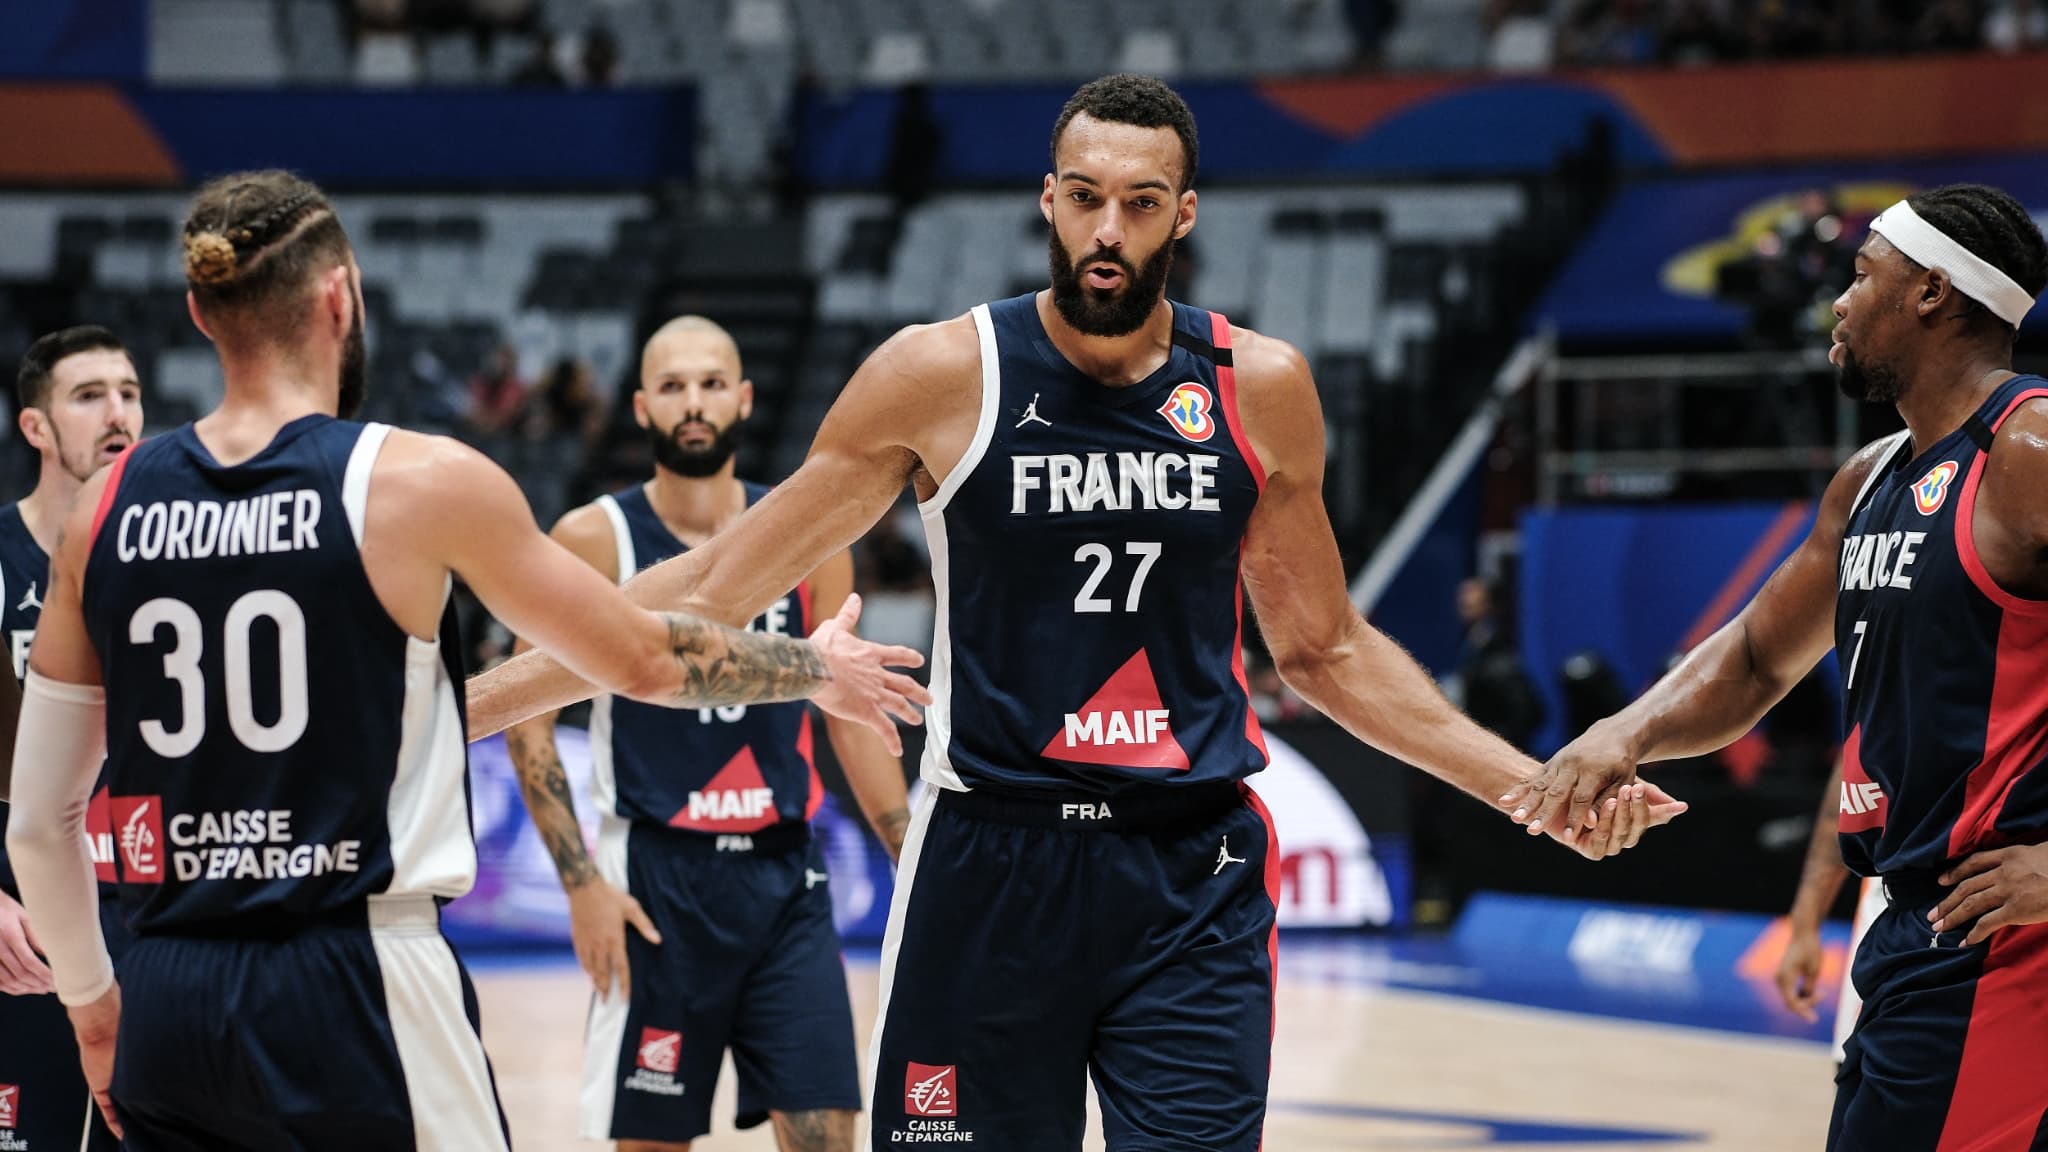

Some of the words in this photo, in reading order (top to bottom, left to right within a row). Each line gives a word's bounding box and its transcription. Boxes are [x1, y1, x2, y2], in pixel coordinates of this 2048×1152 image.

[1009, 451, 1222, 514] FRANCE
[117, 489, 322, 562] CORDINIER
[1073, 541, 1163, 613] 27
[129, 589, 309, 758] 30
[1848, 620, 1868, 690] 7
[1065, 709, 1170, 748] MAIF
[688, 787, 774, 821] MAIF
[1062, 802, 1113, 820] FRA
[1839, 780, 1884, 815] AIF
[169, 809, 292, 847] CAISSE
[173, 839, 361, 882] D'EPARGNE
[891, 1130, 974, 1143] D'EPARGNE
[908, 1120, 956, 1132] CAISSE
